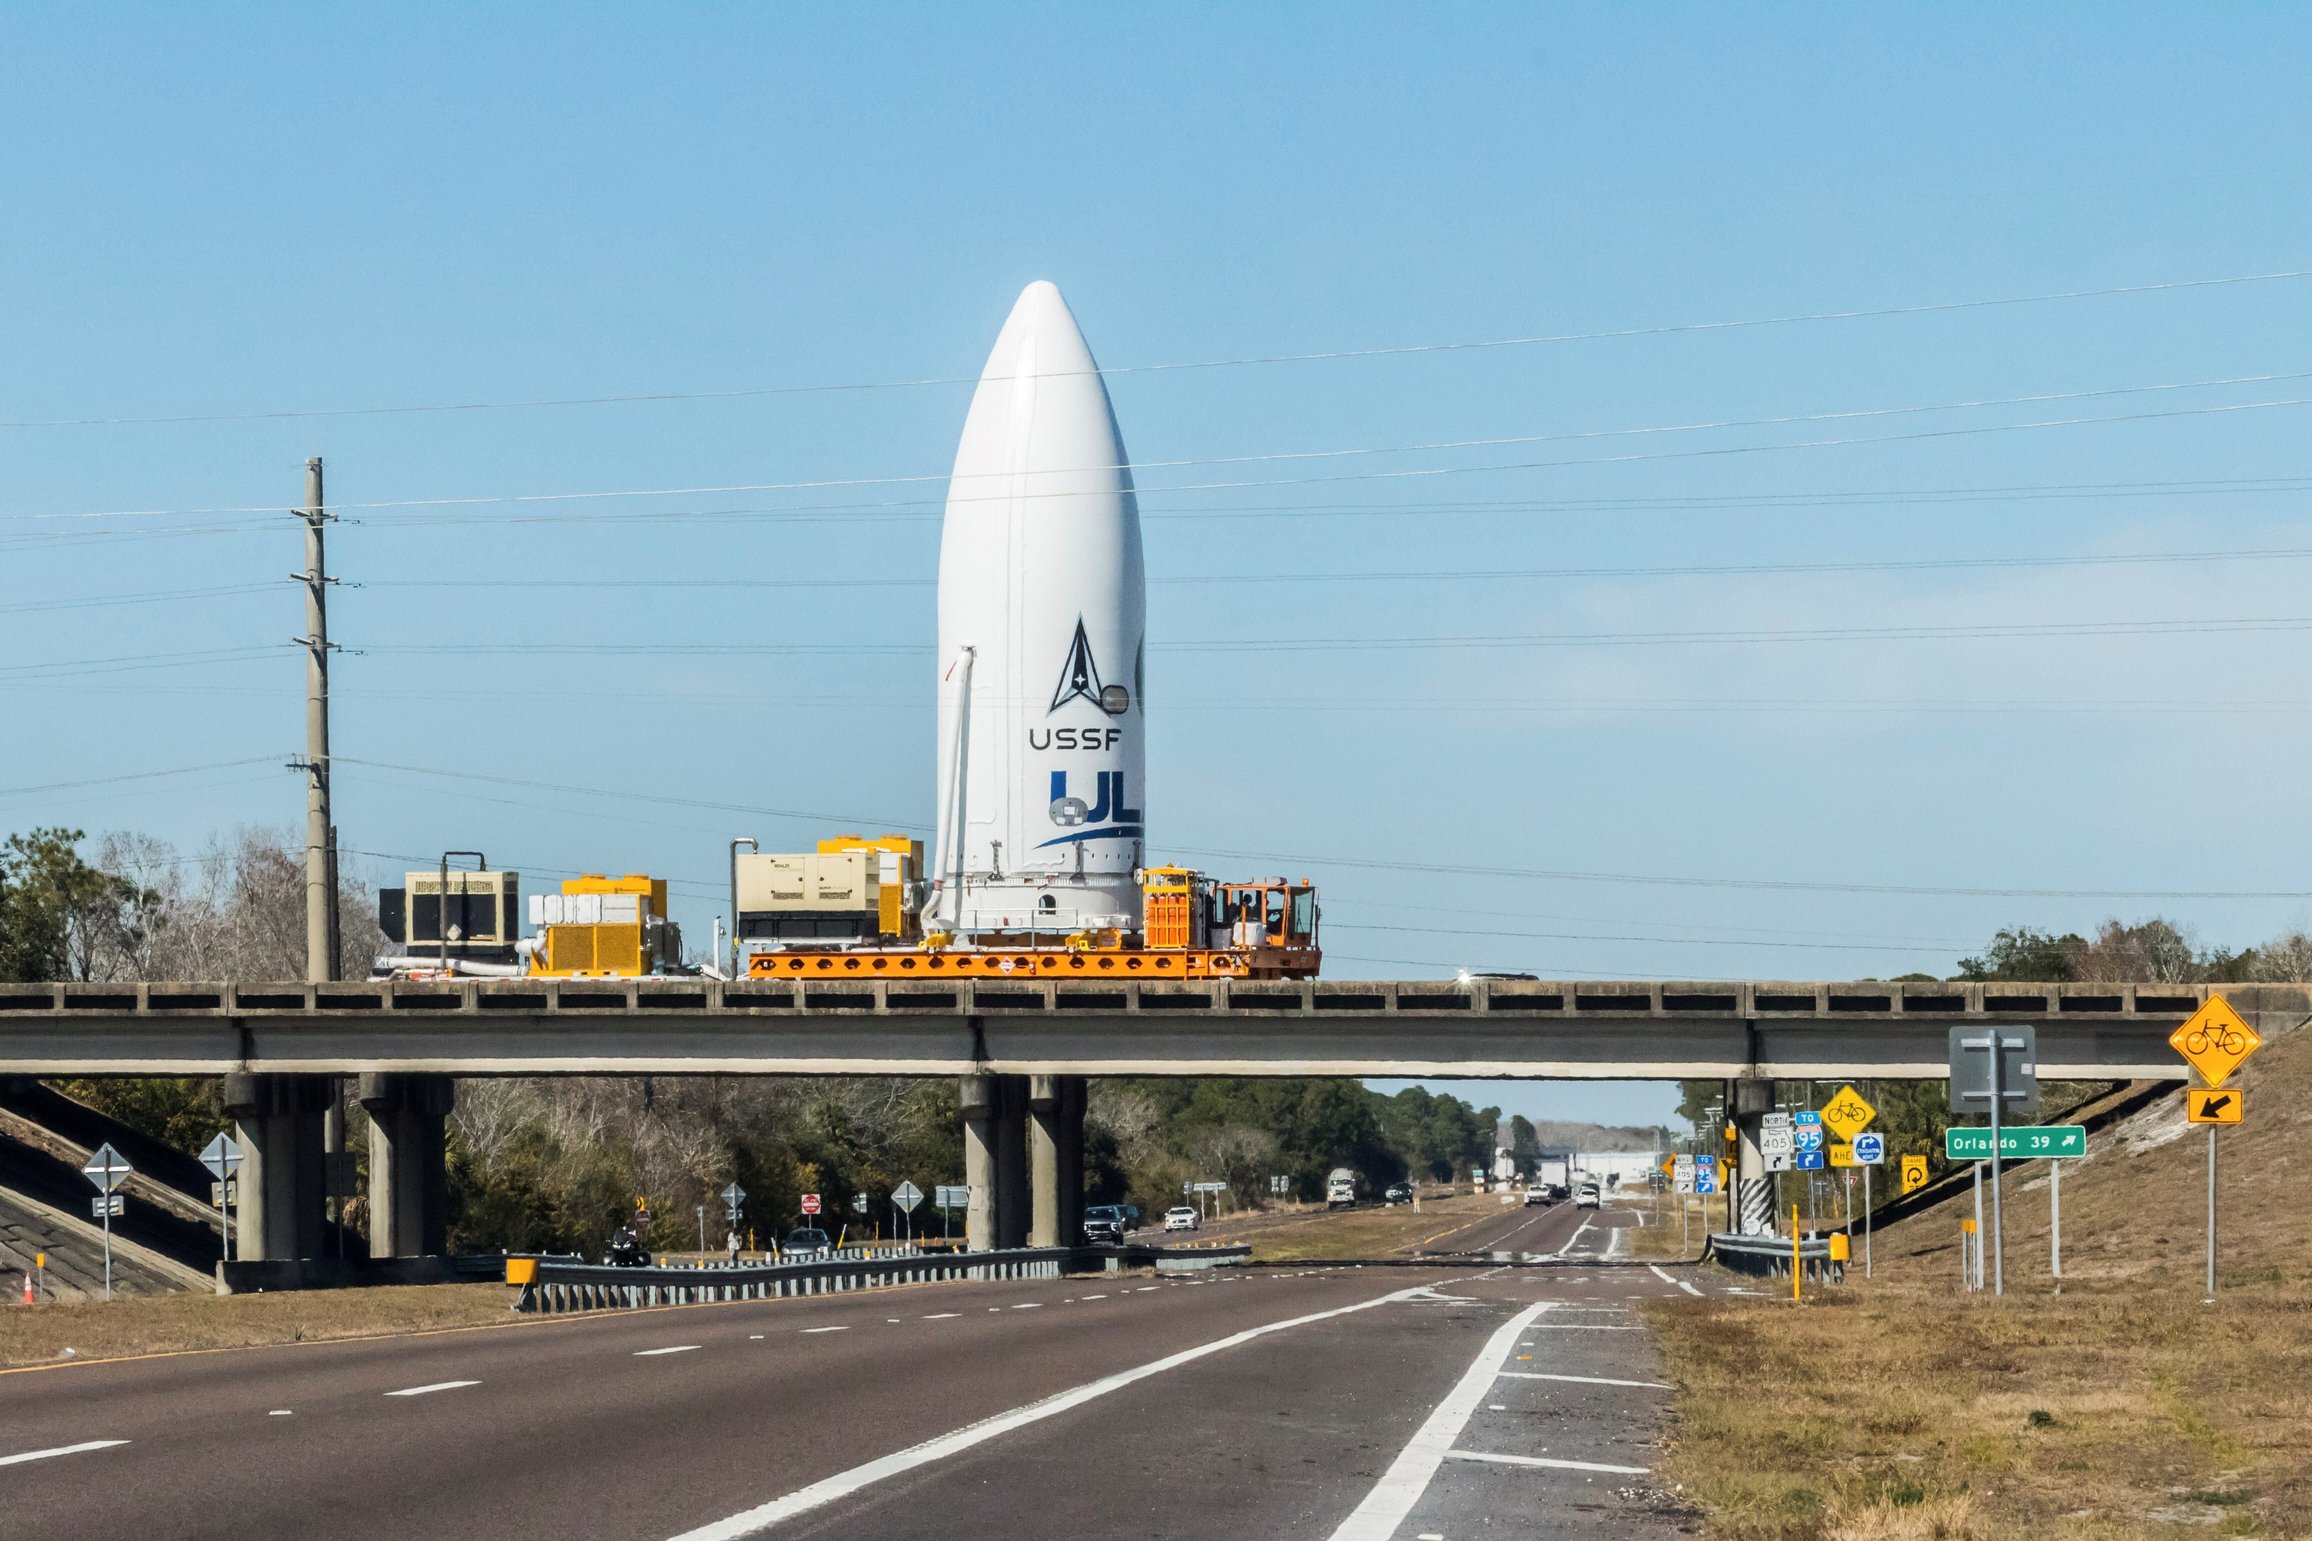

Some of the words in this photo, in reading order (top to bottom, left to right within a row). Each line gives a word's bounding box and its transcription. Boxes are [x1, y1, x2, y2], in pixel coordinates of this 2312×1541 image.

[1029, 728, 1122, 751] USSF
[1050, 771, 1143, 823] UL
[1764, 1116, 1788, 1125] NORTH
[1801, 1114, 1814, 1122] TO
[1763, 1138, 1787, 1148] 405
[1798, 1132, 1820, 1147] 95
[2030, 1136, 2050, 1148] 39
[1833, 1151, 1852, 1161] AHE
[1698, 1169, 1712, 1179] 95
